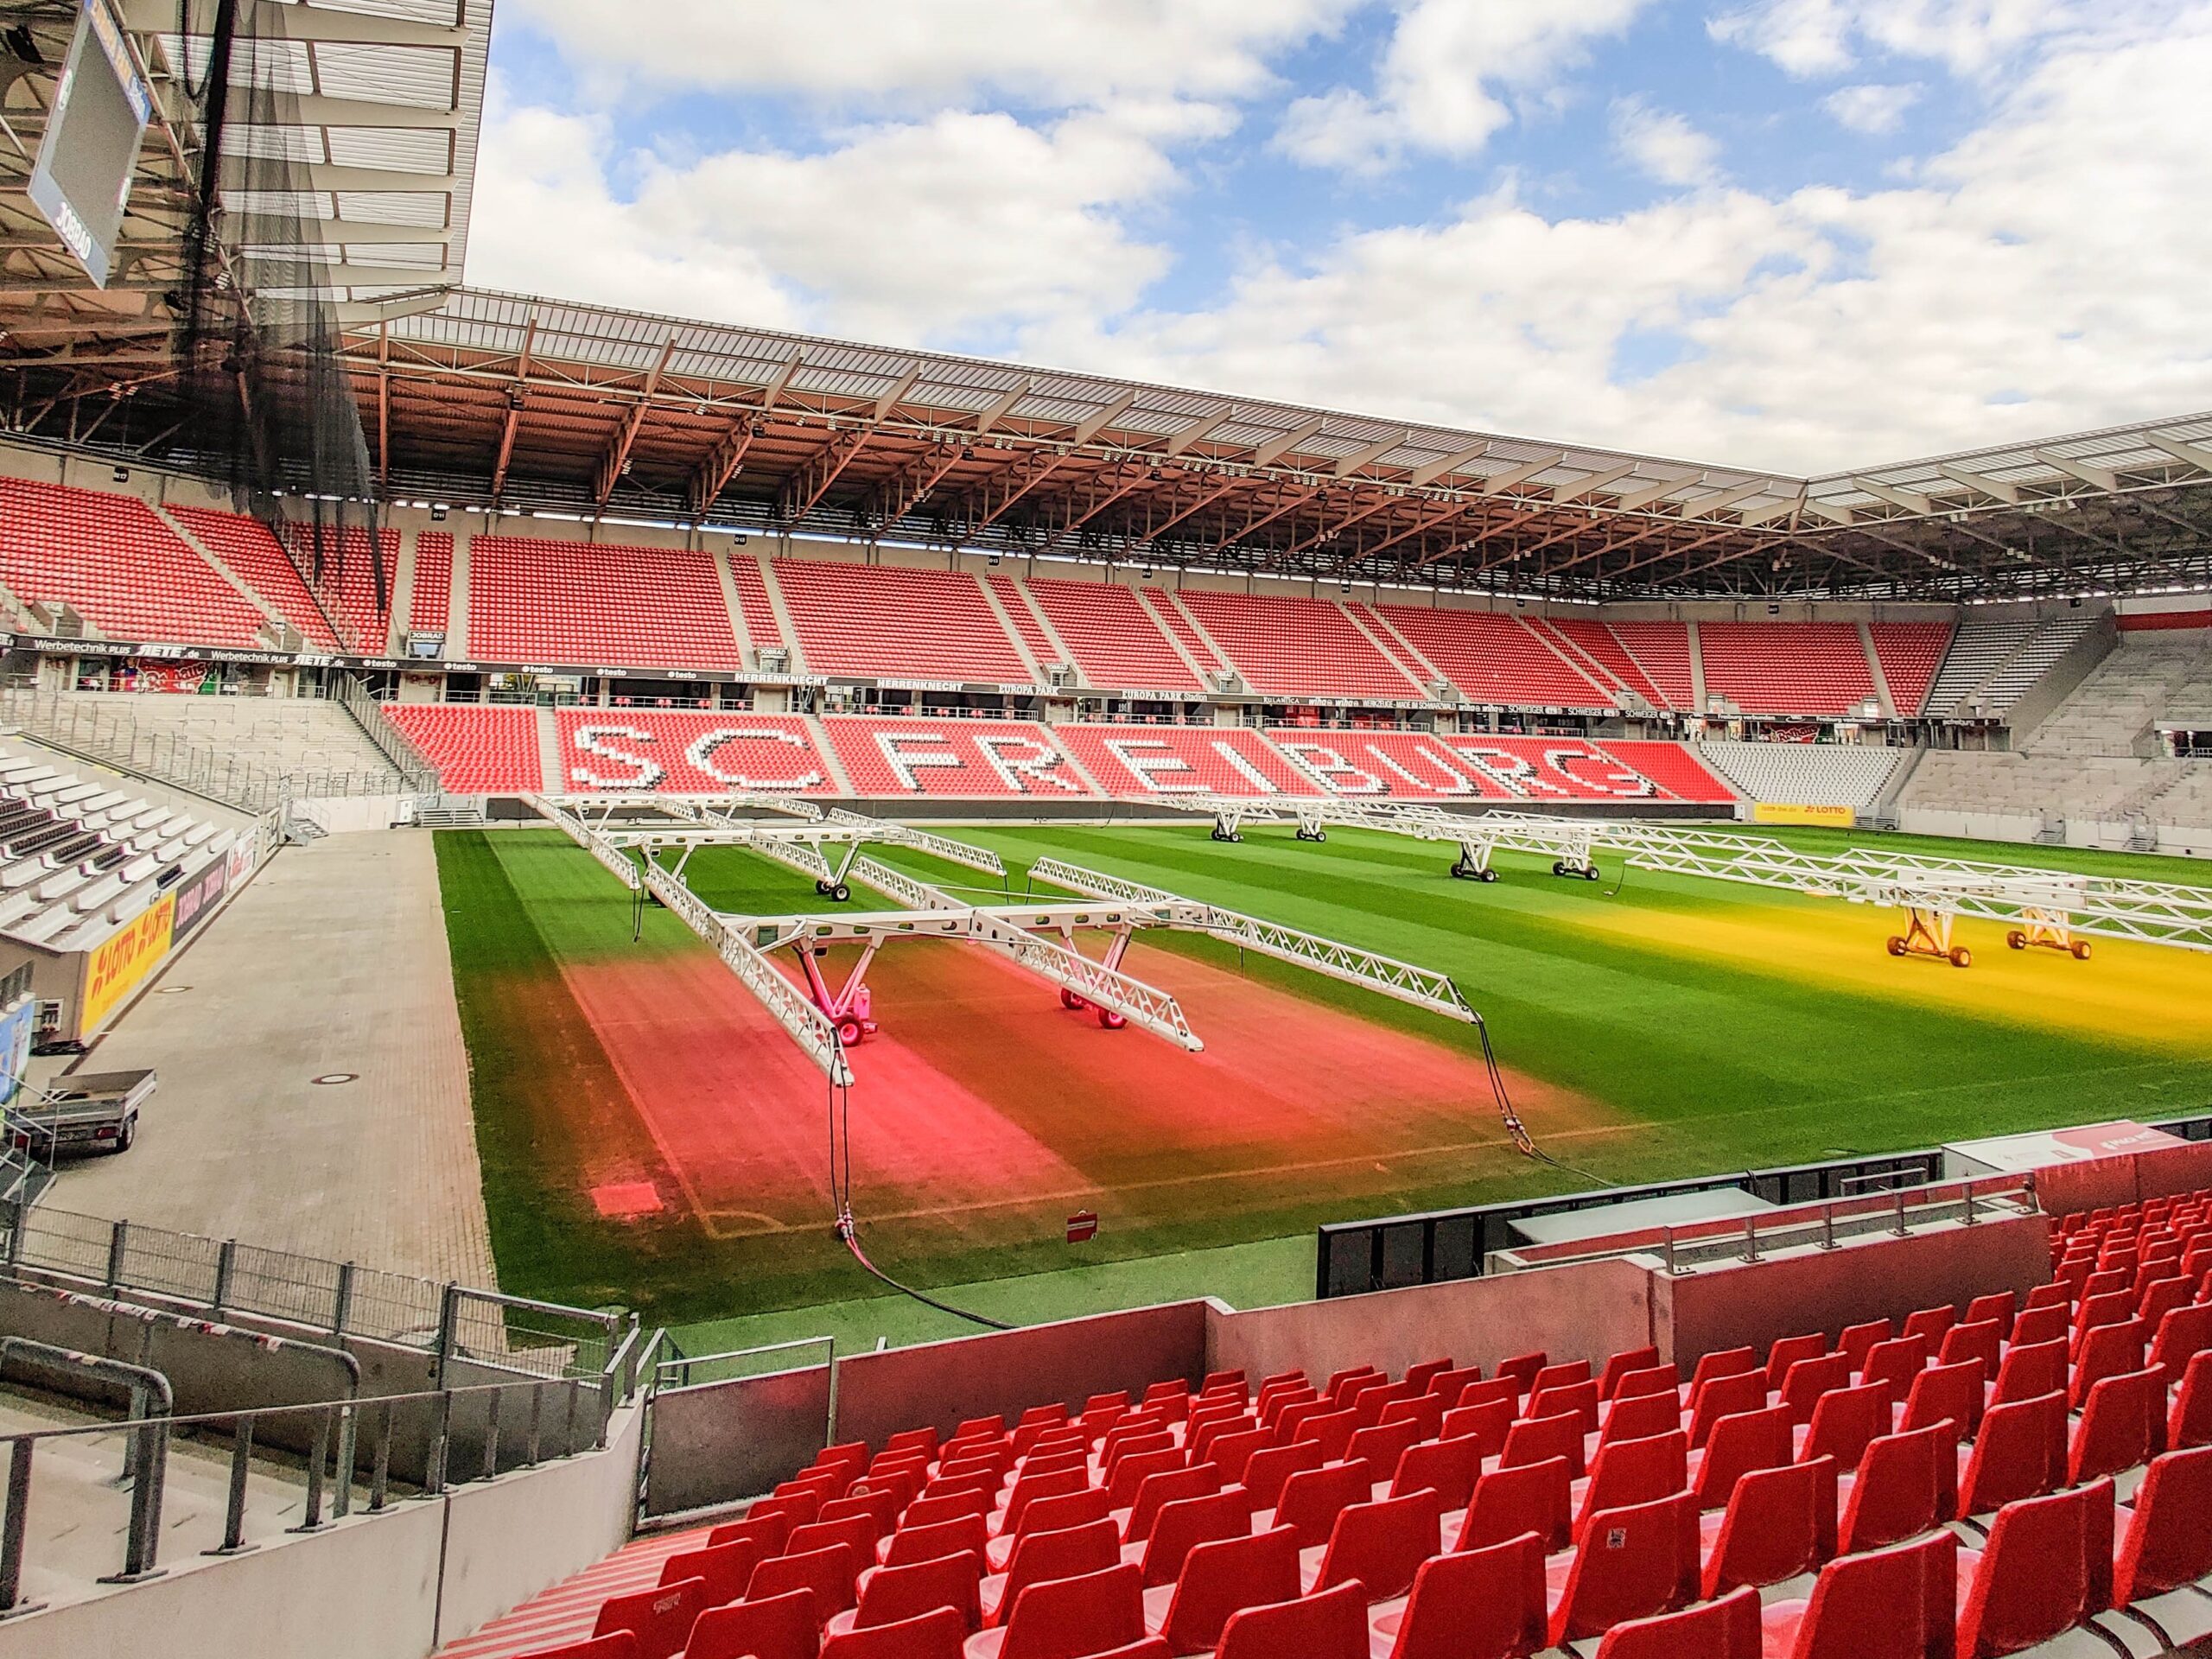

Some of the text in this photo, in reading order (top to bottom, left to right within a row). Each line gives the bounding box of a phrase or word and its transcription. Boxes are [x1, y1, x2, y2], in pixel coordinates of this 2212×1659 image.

[54, 201, 92, 260] JOBRAD
[35, 639, 108, 653] Werbetechnik
[109, 645, 130, 654] PLUS
[211, 651, 270, 663] Werbetechnik
[270, 655, 289, 664] PLUS
[372, 659, 397, 668] testo
[452, 663, 477, 671] testo
[529, 665, 554, 674] testo
[604, 668, 627, 677] testo
[734, 672, 830, 685] HERRENKNECHT
[876, 678, 963, 692] HERRENKNECHT
[998, 684, 1058, 696] EUROPA PARK
[1122, 690, 1208, 702] EUROPA PARK Stadion
[572, 724, 1656, 799] SC FREIBURG
[1816, 806, 1847, 815] LOTTO
[149, 899, 172, 949] LOTTO
[105, 928, 137, 986] LOTTO
